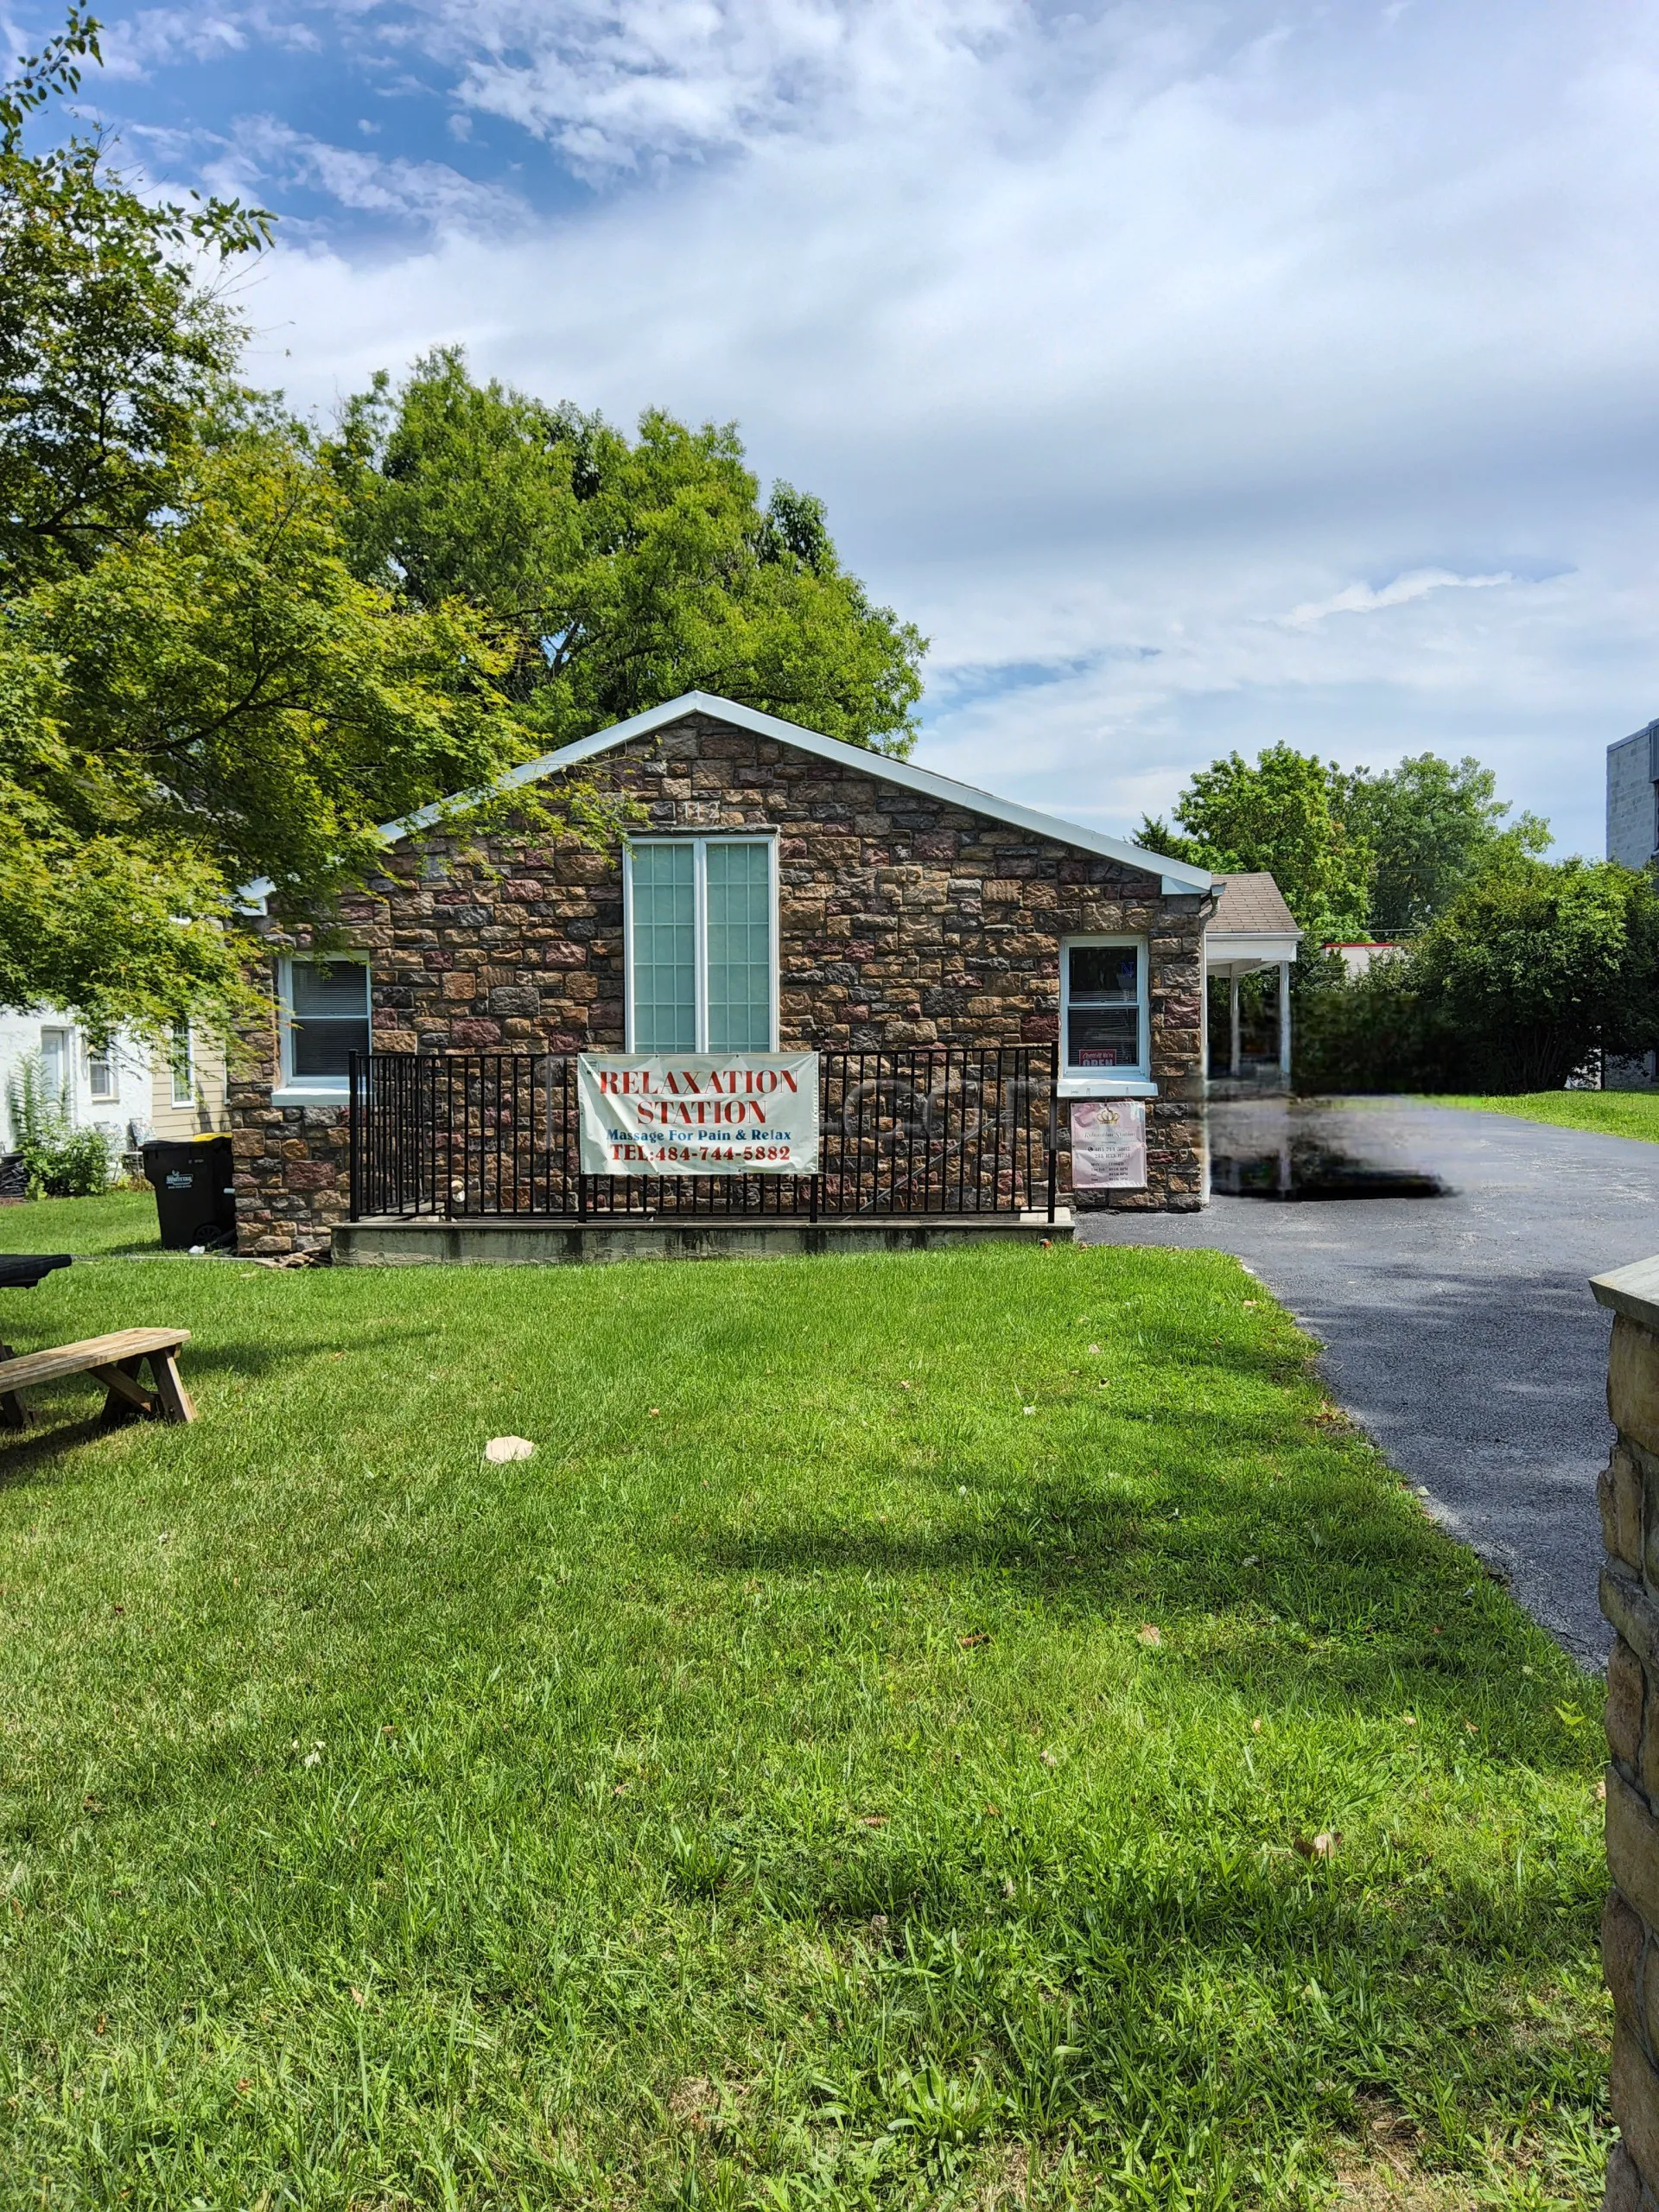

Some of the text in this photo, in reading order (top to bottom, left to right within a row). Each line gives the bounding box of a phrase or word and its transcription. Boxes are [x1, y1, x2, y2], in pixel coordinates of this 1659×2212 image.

[599, 1069, 799, 1095] RELAXATION
[637, 1100, 767, 1124] STATION
[607, 1128, 791, 1143] Massage For Pain & Relax
[611, 1144, 791, 1162] TEL:484-744-5882
